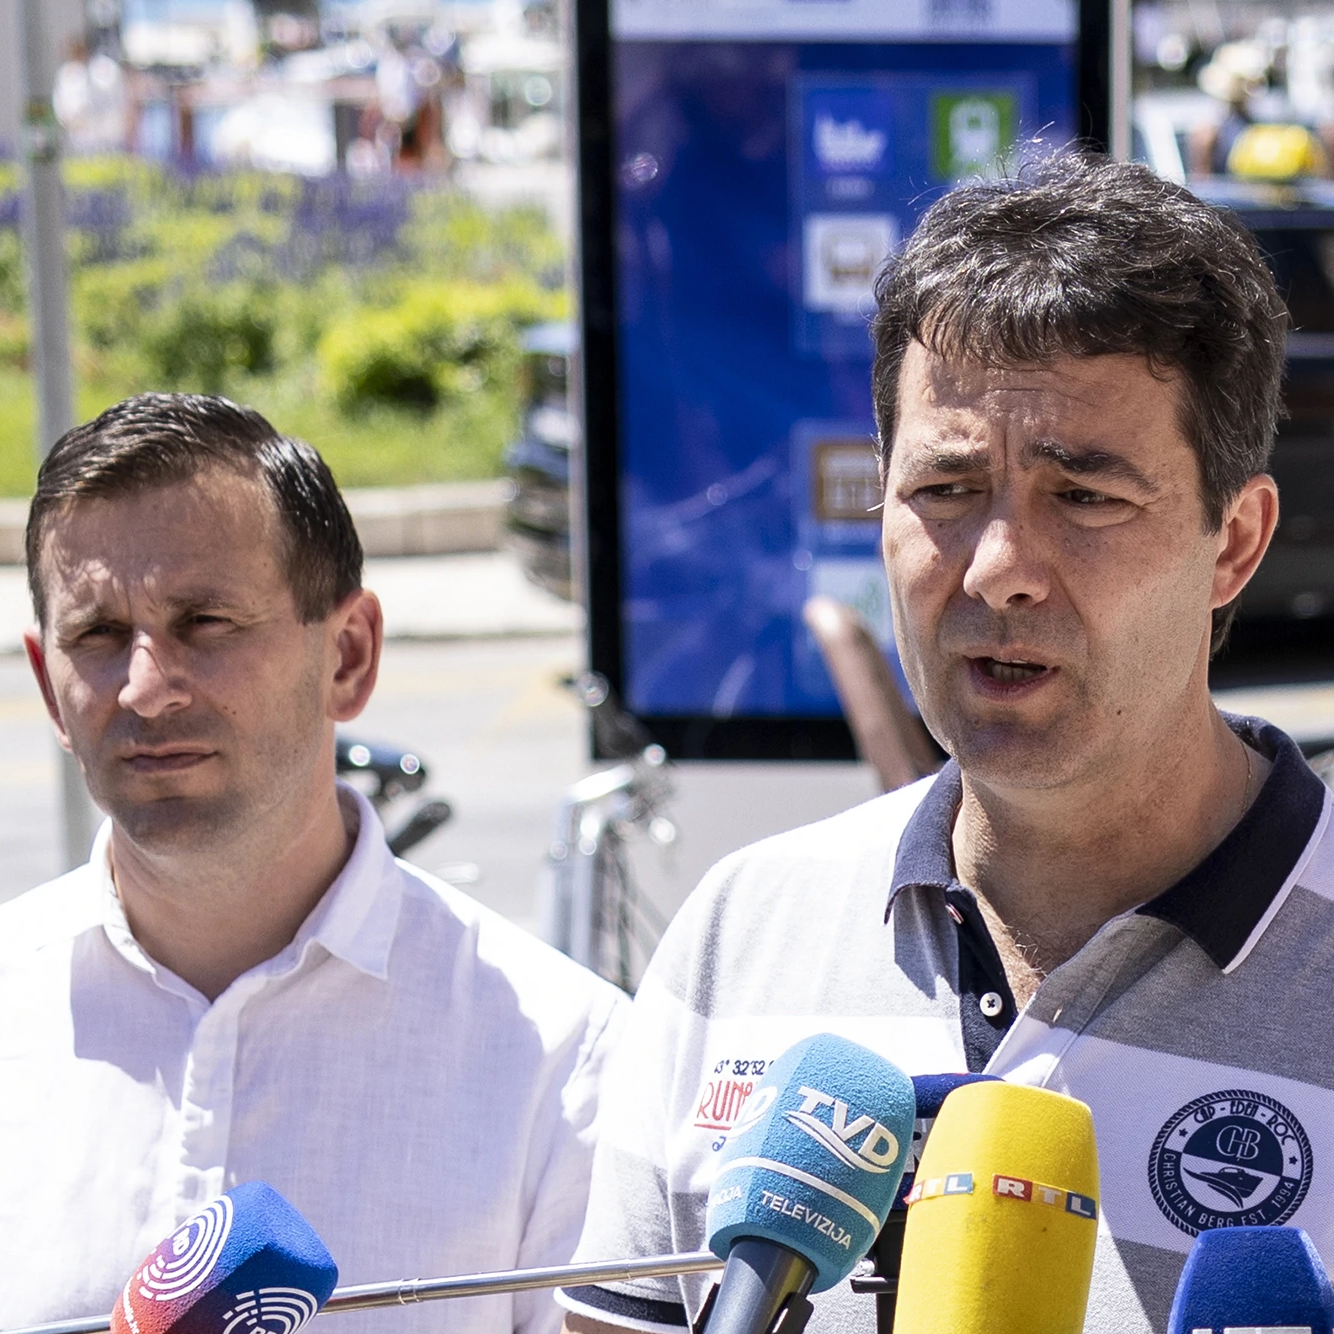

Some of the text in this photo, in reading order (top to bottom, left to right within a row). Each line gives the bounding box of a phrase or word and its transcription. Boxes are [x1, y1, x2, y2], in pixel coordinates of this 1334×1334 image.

[797, 1086, 900, 1167] TVD
[1266, 1114, 1296, 1146] ROC
[762, 1190, 852, 1250] TELEVIZIJA
[996, 1177, 1091, 1216] RTL
[1162, 1153, 1196, 1218] CHRISTIAN
[1198, 1213, 1234, 1228] BERG
[1271, 1182, 1295, 1208] 1994
